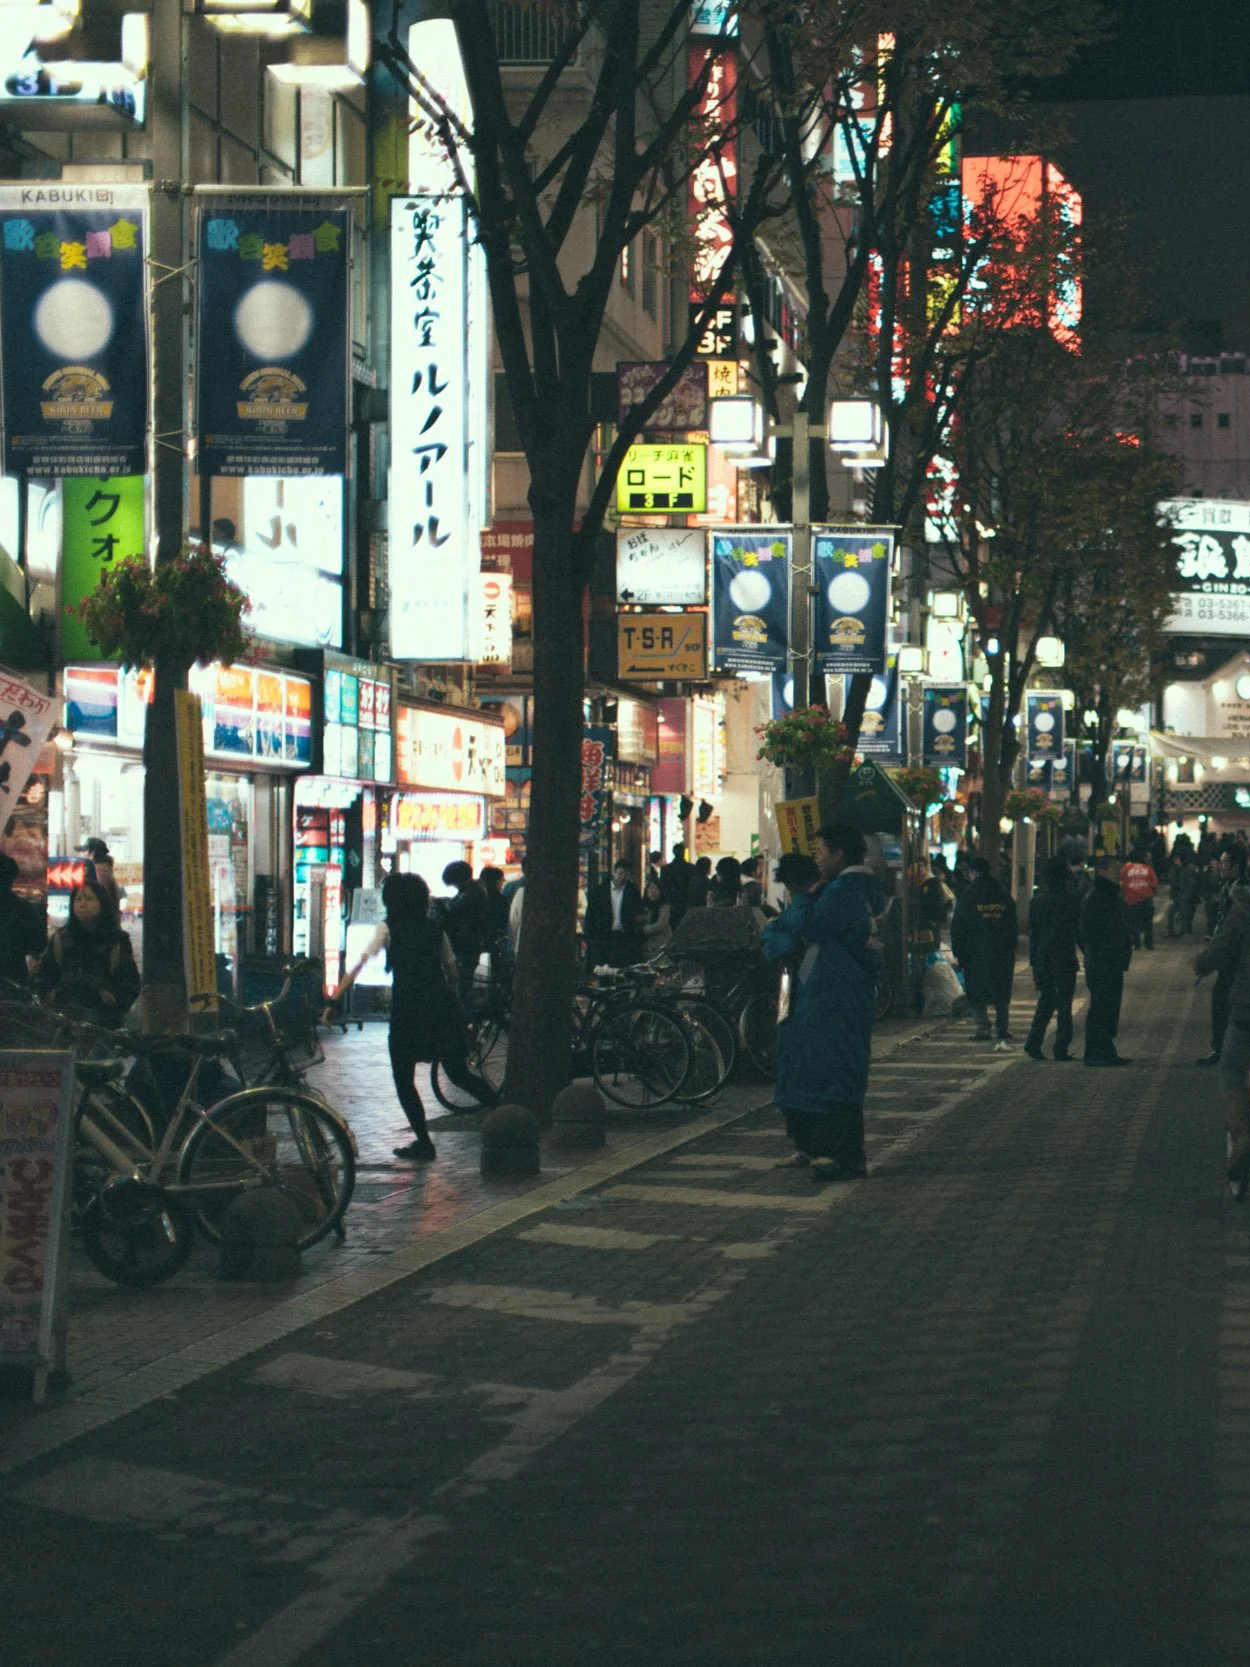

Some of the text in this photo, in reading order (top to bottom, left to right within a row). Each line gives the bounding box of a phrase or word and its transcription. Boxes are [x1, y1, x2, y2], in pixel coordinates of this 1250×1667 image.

[697, 331, 732, 354] 3F
[409, 207, 452, 549] 喫茶室ルノアール
[627, 466, 695, 488] ロード
